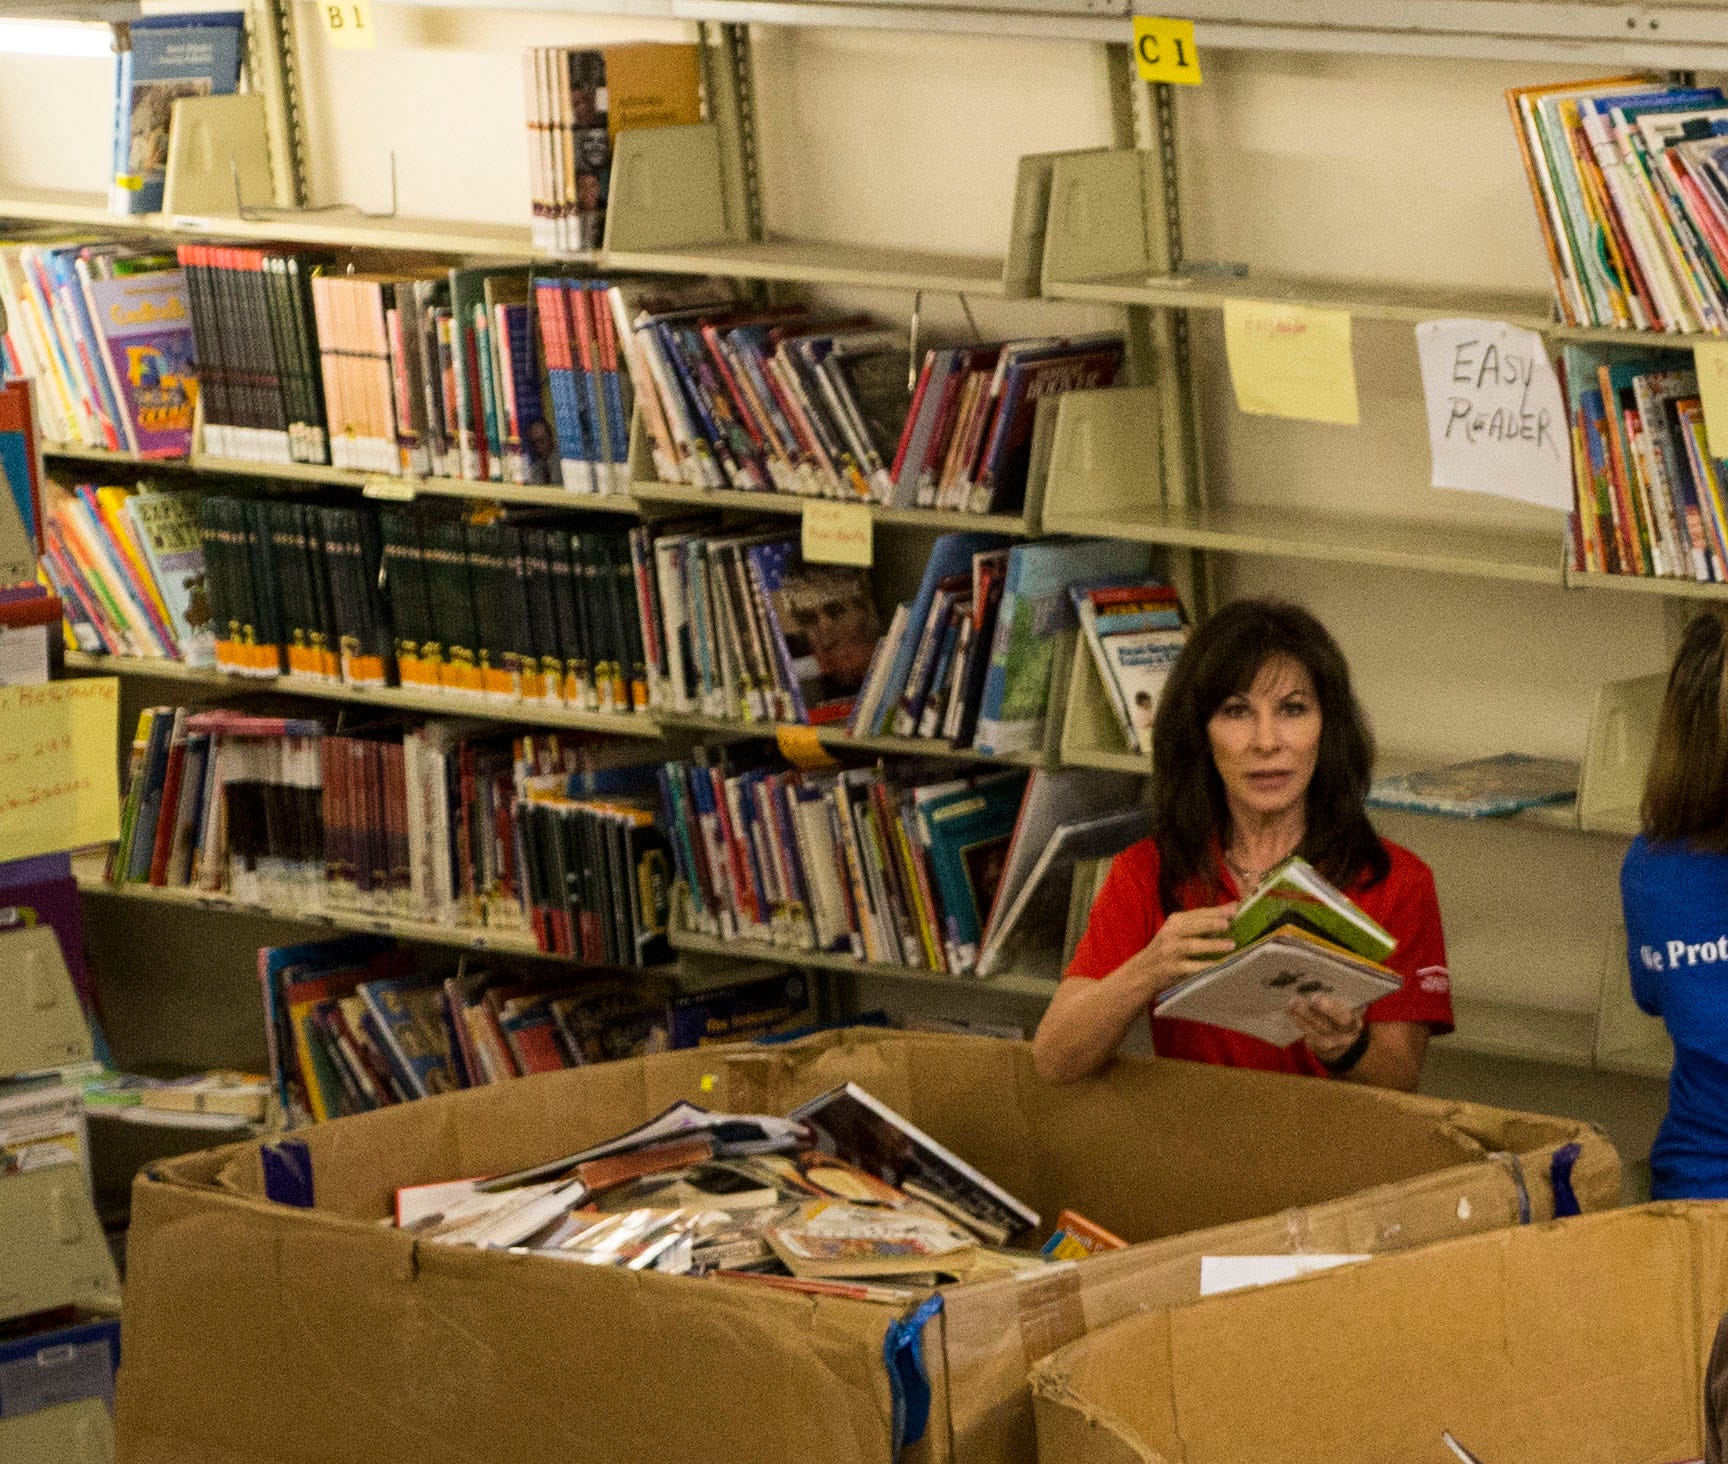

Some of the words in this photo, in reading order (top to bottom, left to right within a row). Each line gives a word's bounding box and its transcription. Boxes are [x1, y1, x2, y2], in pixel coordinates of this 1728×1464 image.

[327, 5, 344, 28] B
[353, 5, 365, 28] 1
[1139, 35, 1160, 65] C
[1174, 39, 1190, 68] 1
[1453, 340, 1535, 400] EASY
